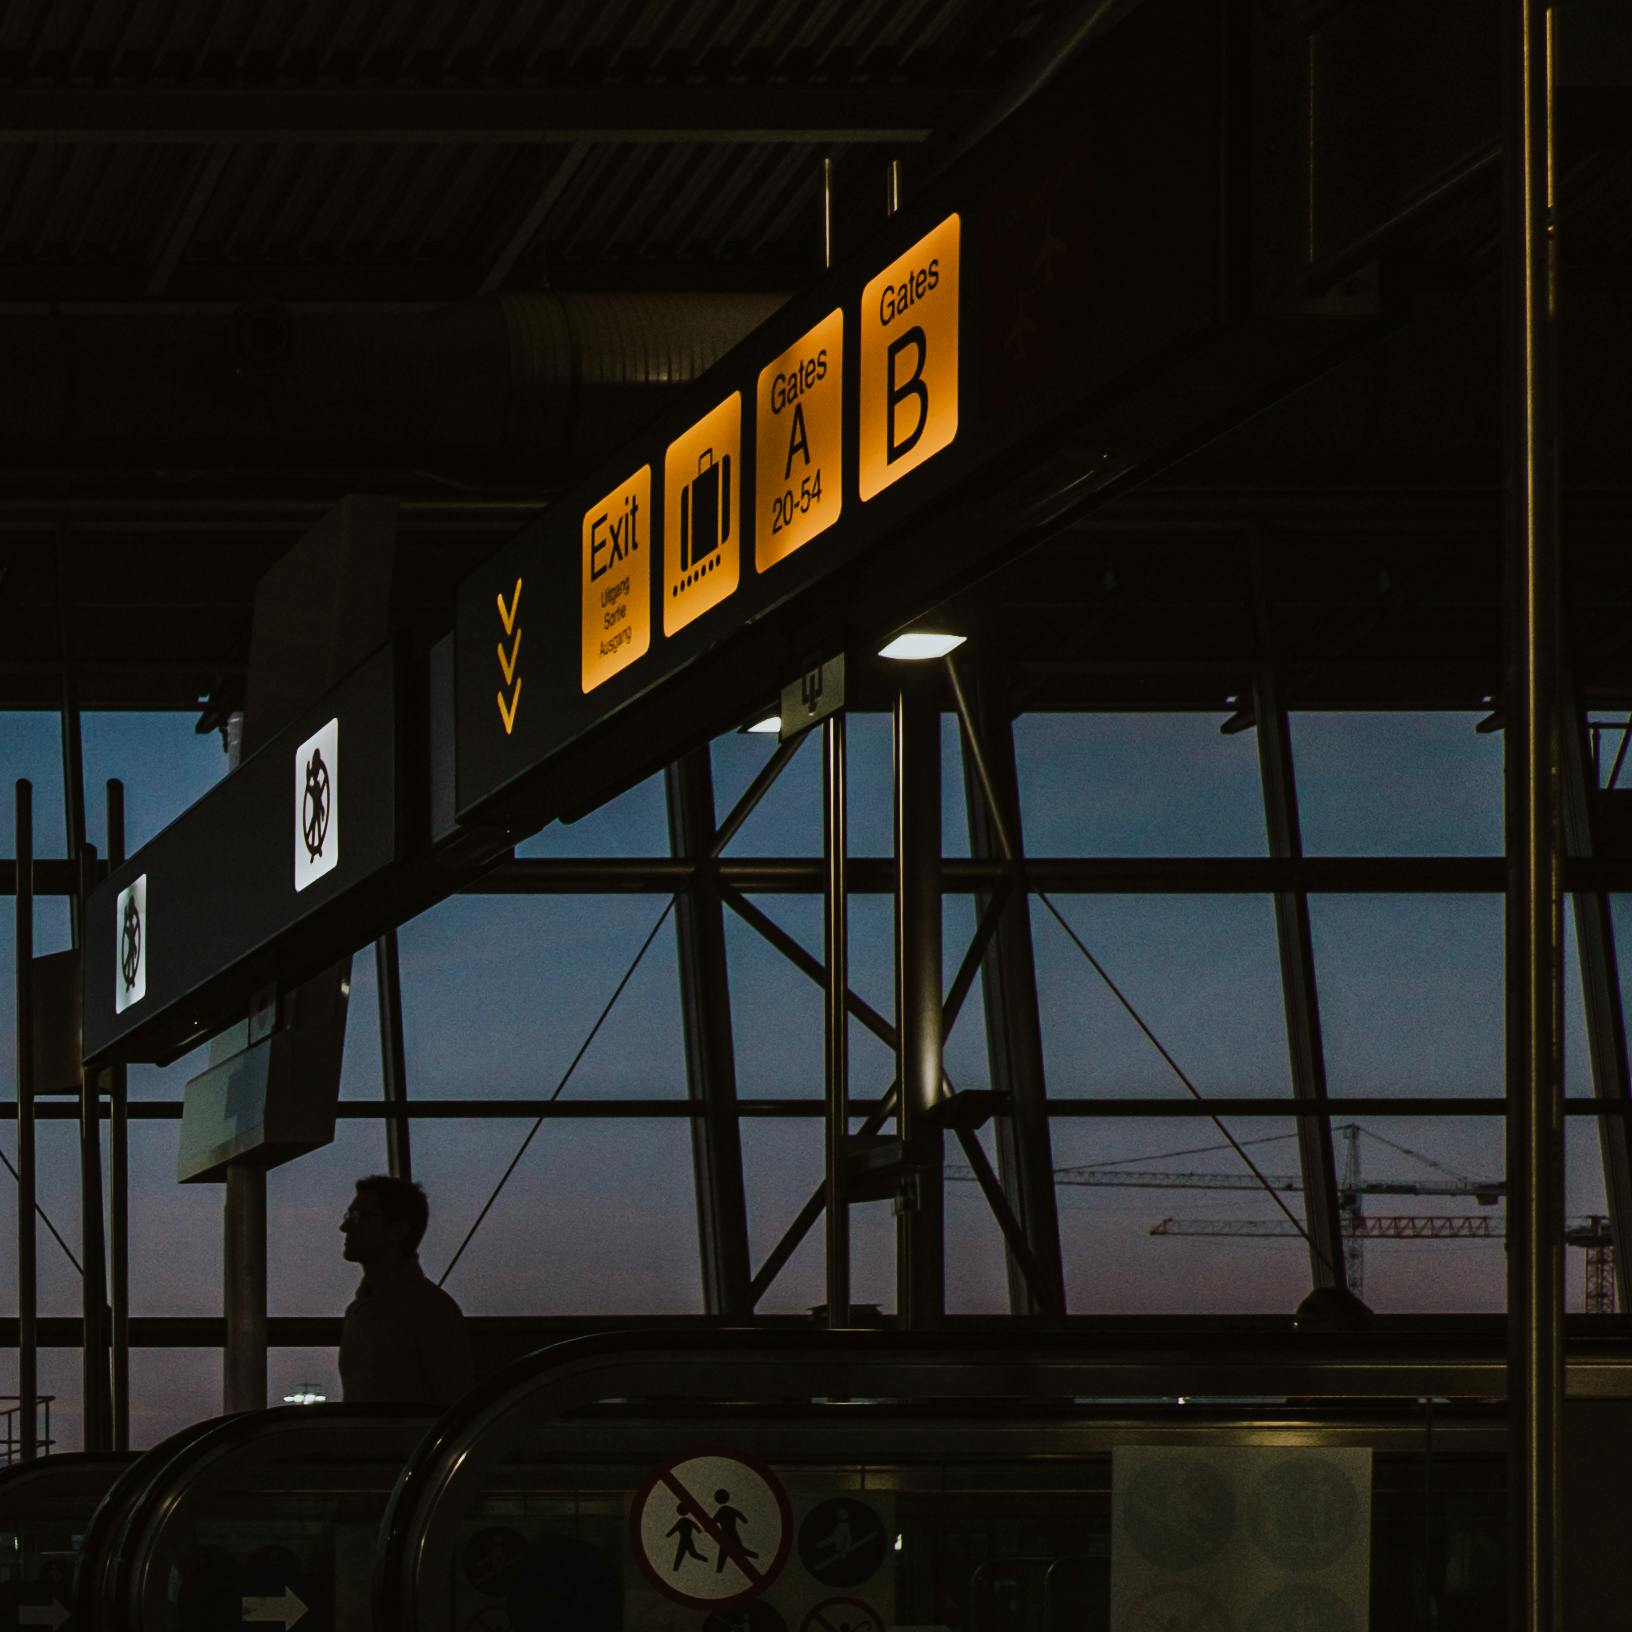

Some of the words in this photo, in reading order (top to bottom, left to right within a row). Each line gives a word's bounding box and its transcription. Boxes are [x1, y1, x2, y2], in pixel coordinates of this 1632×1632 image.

[880, 259, 939, 326] Gates
[771, 349, 827, 415] Gates
[887, 326, 928, 466] B
[785, 402, 810, 480] A
[772, 469, 822, 534] 20-54
[591, 495, 638, 581] Exit
[599, 626, 632, 658] Ausgang
[604, 604, 627, 630] Sortie
